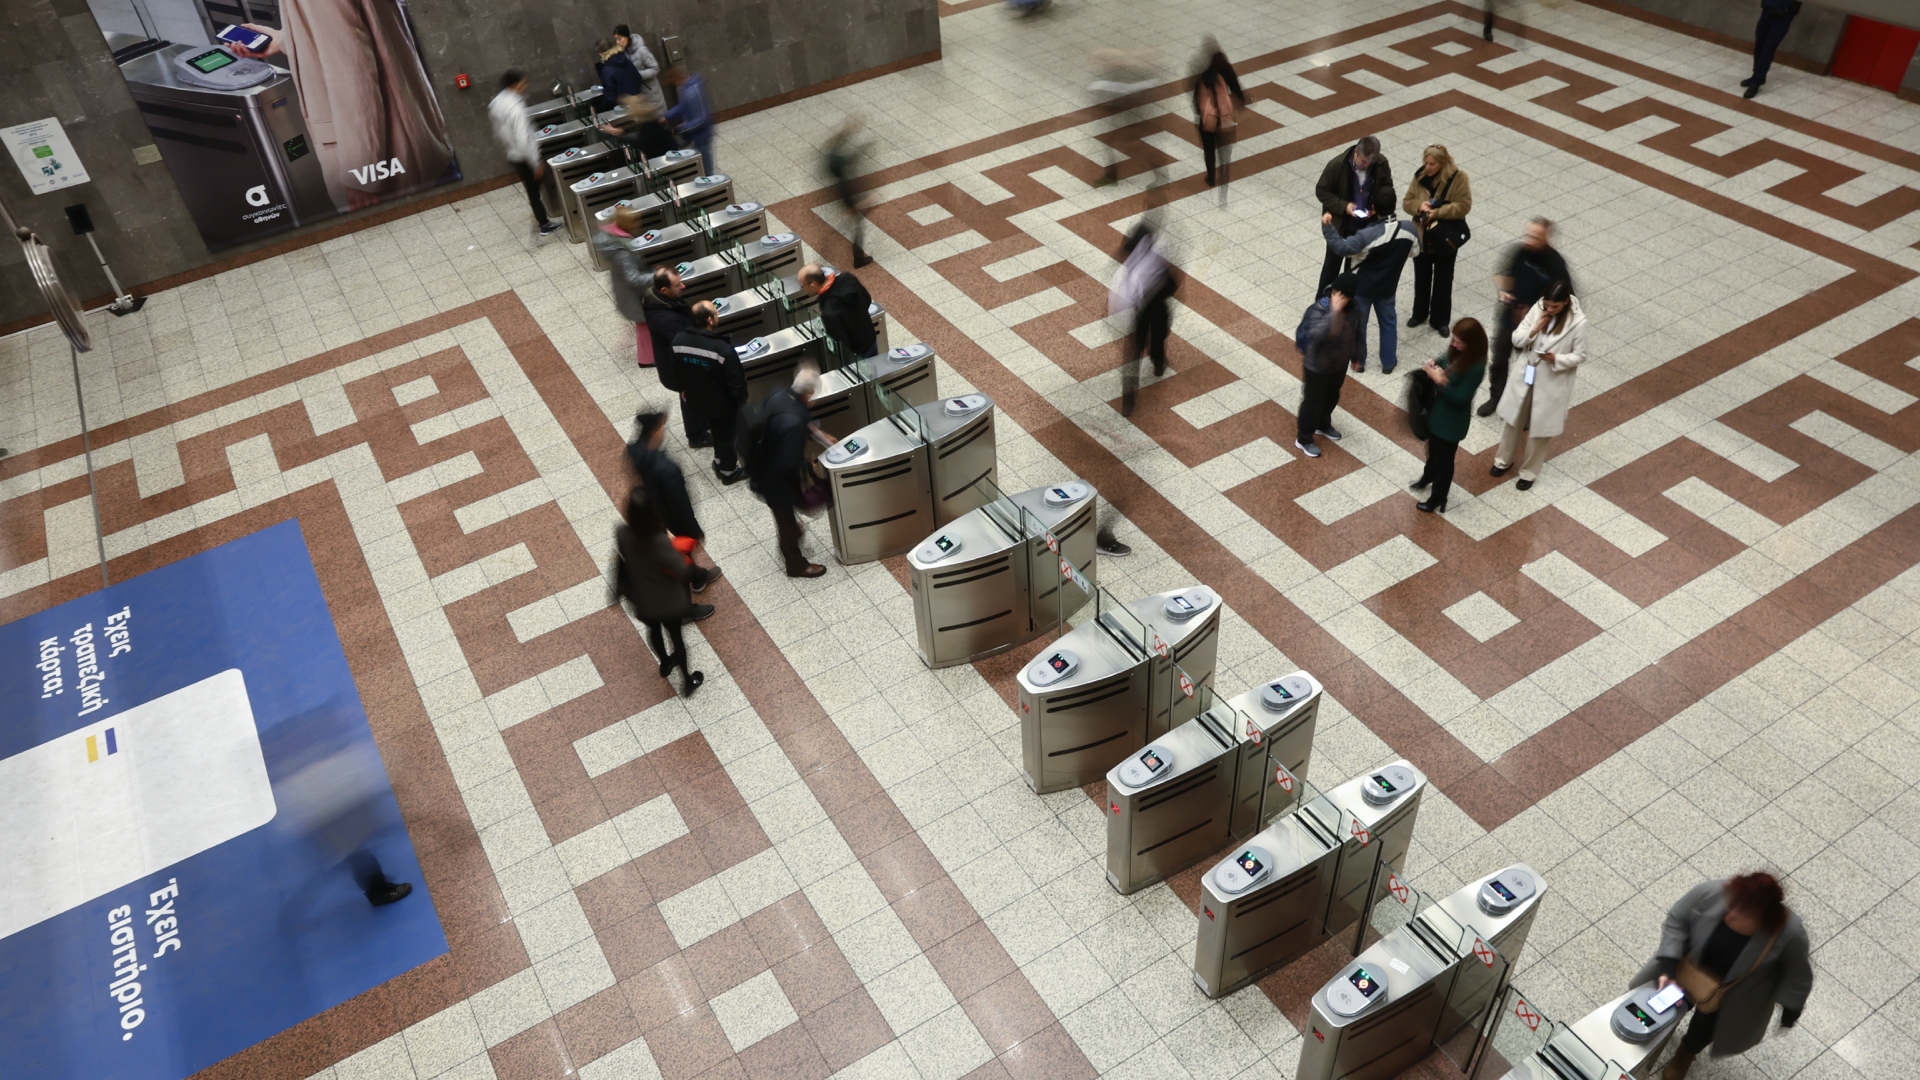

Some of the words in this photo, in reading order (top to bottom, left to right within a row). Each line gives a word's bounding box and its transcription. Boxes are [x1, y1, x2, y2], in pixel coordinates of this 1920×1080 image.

[347, 157, 406, 185] VISA
[242, 204, 287, 220] συγκοινωνίες
[254, 212, 280, 224] αθηνών
[103, 606, 131, 658] Έχεις
[36, 635, 66, 699] κάρτα;
[69, 622, 109, 717] τραπεζική
[145, 877, 181, 958] Έχεις
[107, 904, 147, 1042] εισιτήριο.
